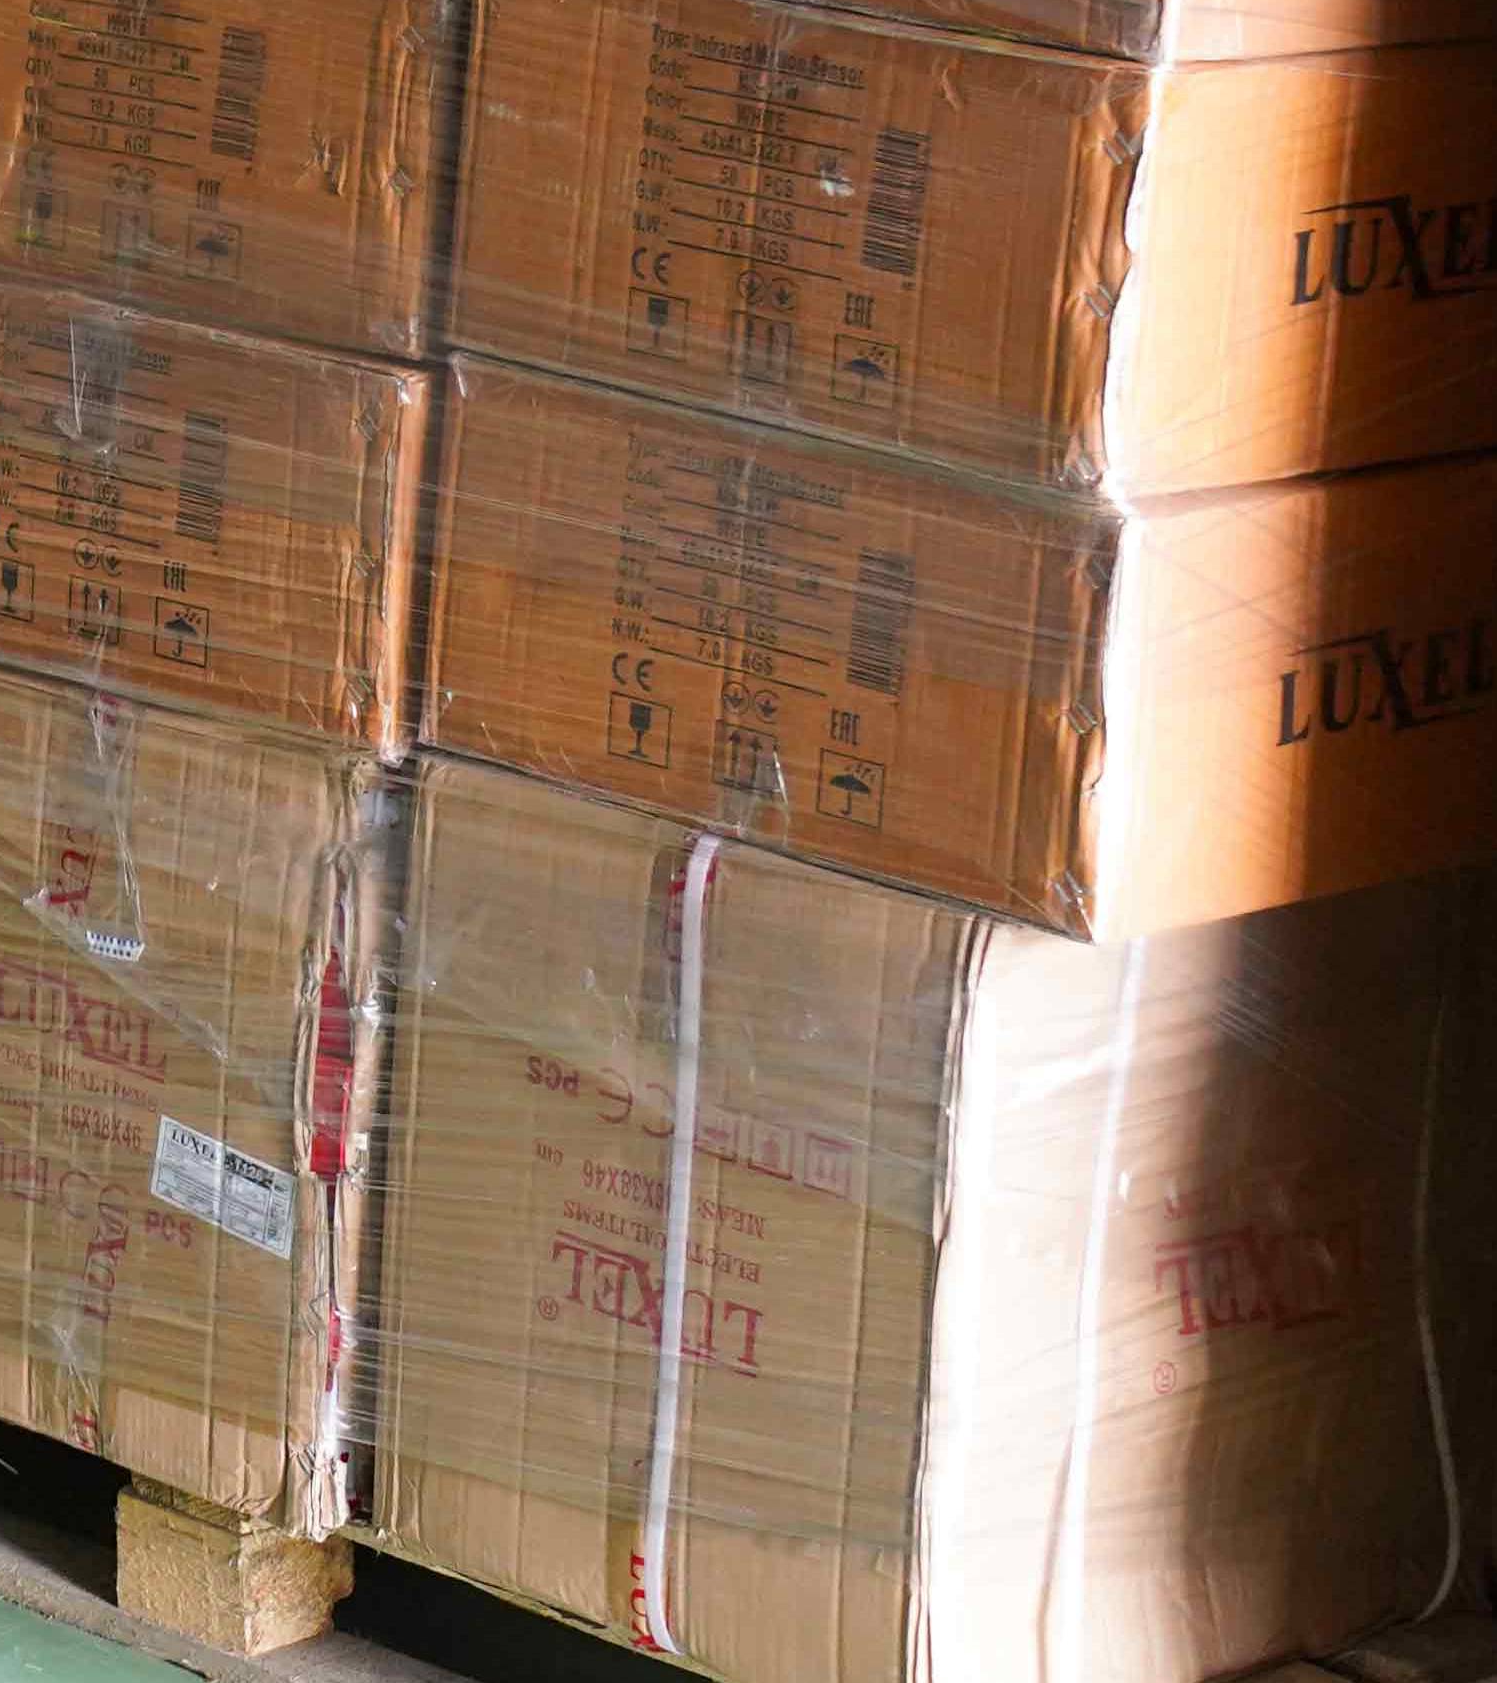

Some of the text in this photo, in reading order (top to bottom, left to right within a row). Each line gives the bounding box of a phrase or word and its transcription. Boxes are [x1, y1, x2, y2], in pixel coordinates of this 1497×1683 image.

[651, 22, 691, 53] Type:
[128, 73, 156, 97] PCS
[125, 102, 157, 126] KGS
[122, 133, 152, 157] KGS
[638, 148, 672, 175] QTY:
[763, 174, 795, 199] PCS
[759, 206, 795, 232] KGS
[755, 238, 790, 264] KGS
[744, 619, 778, 645] KGS
[741, 649, 774, 676] KGS
[525, 1054, 581, 1100] PCS
[145, 1208, 195, 1250] PCS
